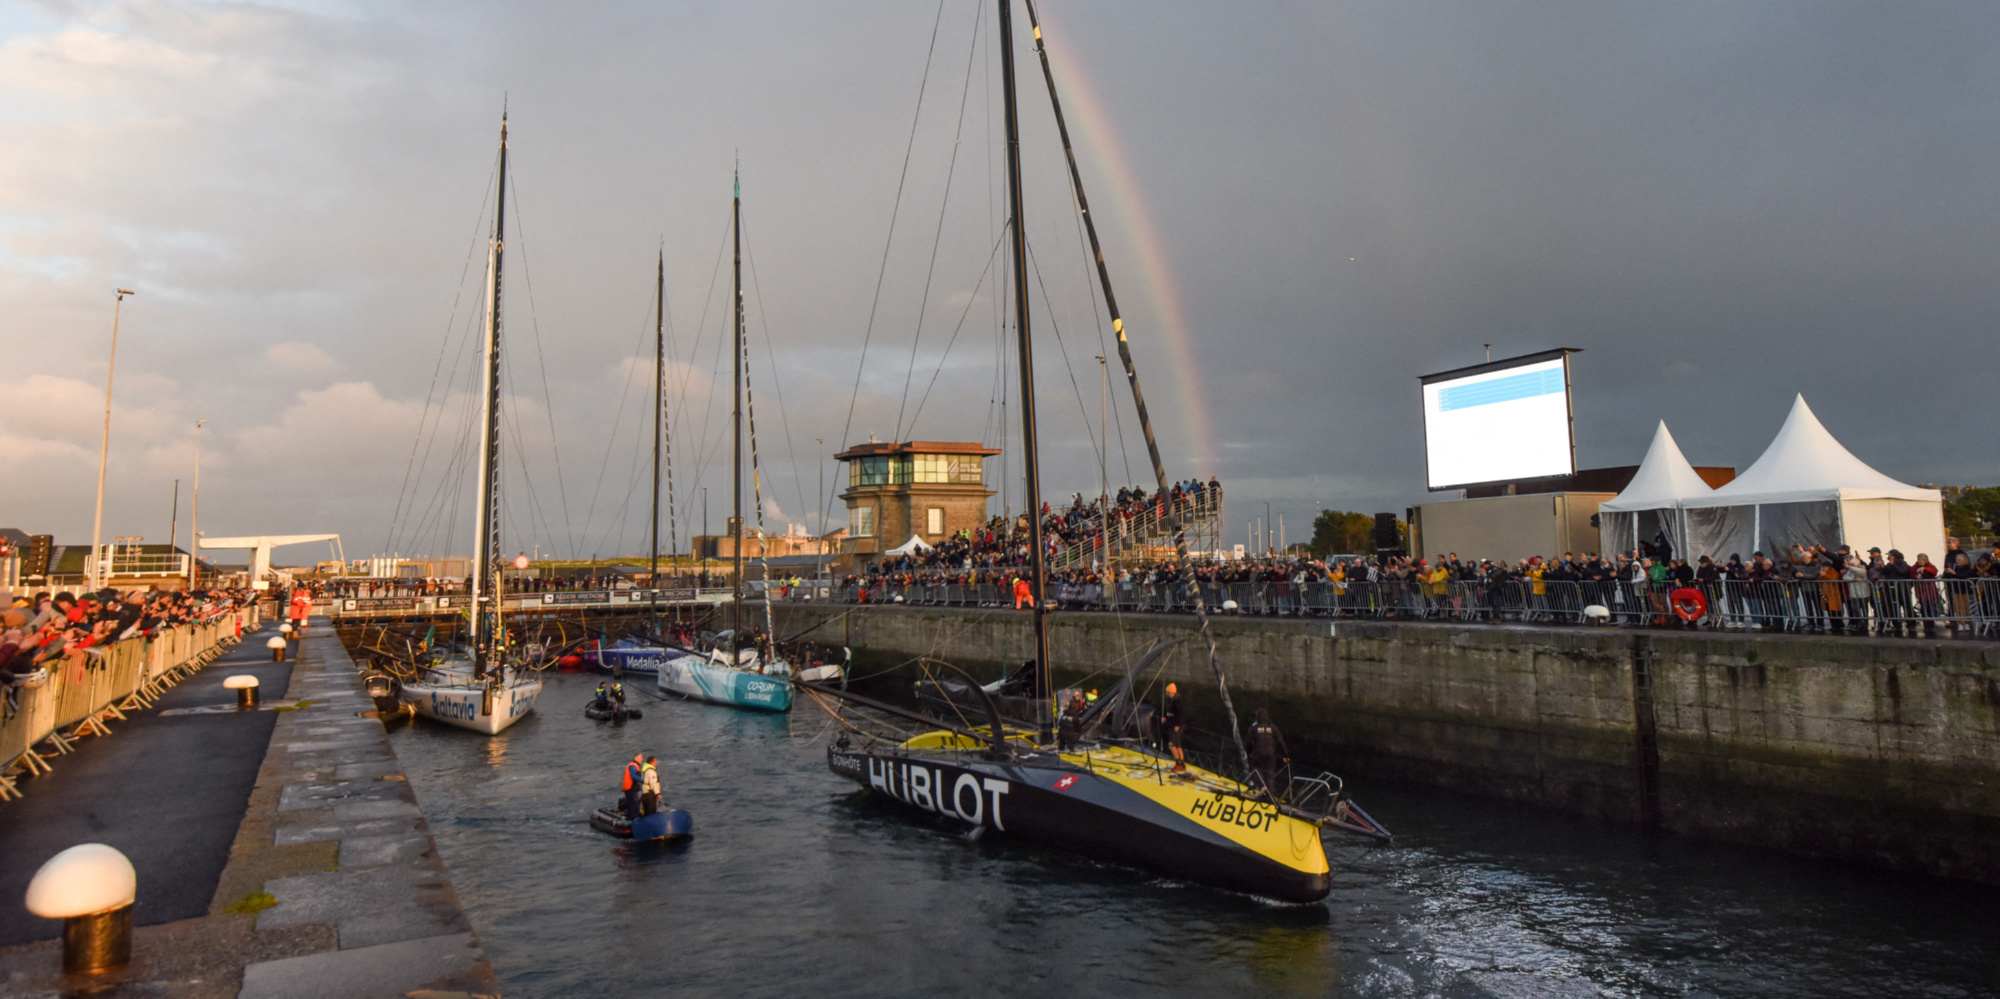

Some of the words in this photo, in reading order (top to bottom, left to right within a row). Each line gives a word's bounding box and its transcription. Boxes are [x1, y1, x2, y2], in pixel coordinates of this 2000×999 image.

[382, 598, 413, 606] BRETAGNE
[555, 592, 577, 600] RÉGION
[578, 591, 607, 599] BRETAGNE
[626, 655, 660, 671] Medallia
[747, 681, 776, 693] CORUM
[440, 695, 475, 721] altavia
[832, 754, 861, 771] BONHÔTE
[868, 757, 1009, 832] HUBLOT
[1190, 798, 1277, 832] HUBLOT
